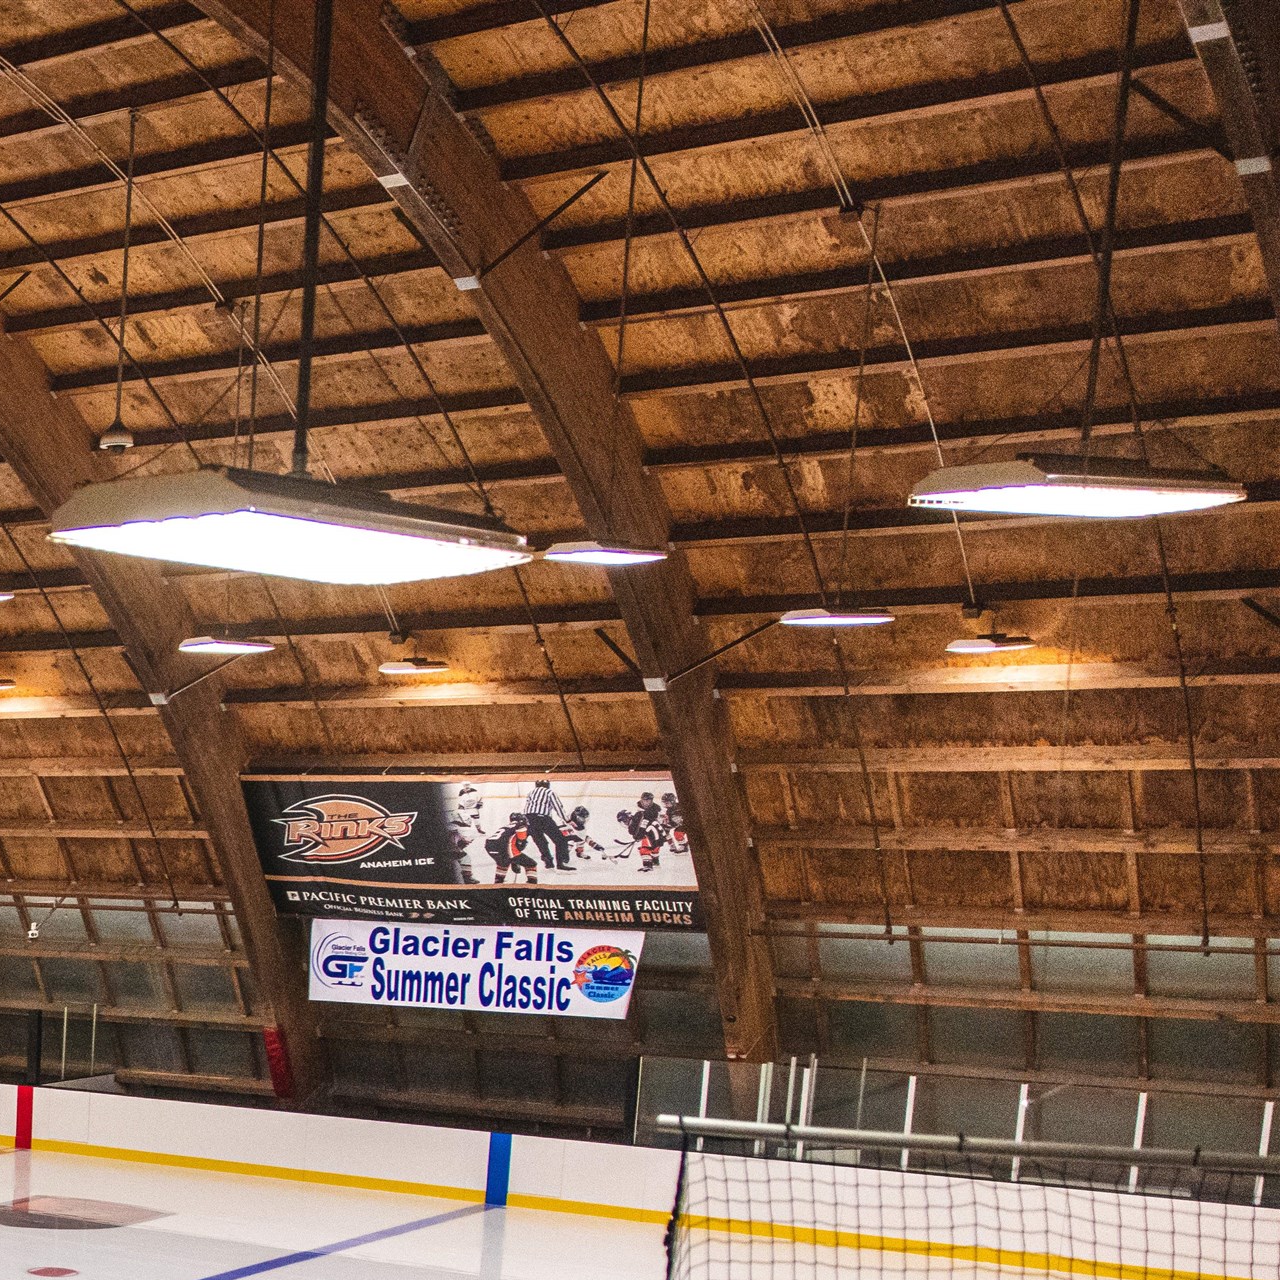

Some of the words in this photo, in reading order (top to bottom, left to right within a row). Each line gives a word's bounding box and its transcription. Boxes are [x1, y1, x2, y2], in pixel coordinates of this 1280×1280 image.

[359, 859, 413, 869] ANAHEIM
[415, 857, 435, 866] ICE
[302, 891, 357, 904] PACIFIC
[359, 895, 423, 909] PREMIER
[426, 899, 472, 911] BANK
[324, 903, 353, 912] OFFICIAL
[354, 907, 385, 916] BUSINESS
[508, 896, 565, 910] OFFICIAL
[567, 898, 630, 911] TRAINING
[635, 899, 693, 913] FACILITY
[515, 907, 531, 919] OF
[535, 909, 560, 921] THE
[563, 910, 635, 923] ANAHEIM
[640, 911, 693, 925] DUCKS
[369, 926, 486, 959] Glacier
[495, 931, 574, 963] Falls
[322, 954, 370, 979] GF
[586, 953, 608, 967] FALLS
[370, 956, 471, 1006] Summer
[478, 962, 572, 1012] Classic
